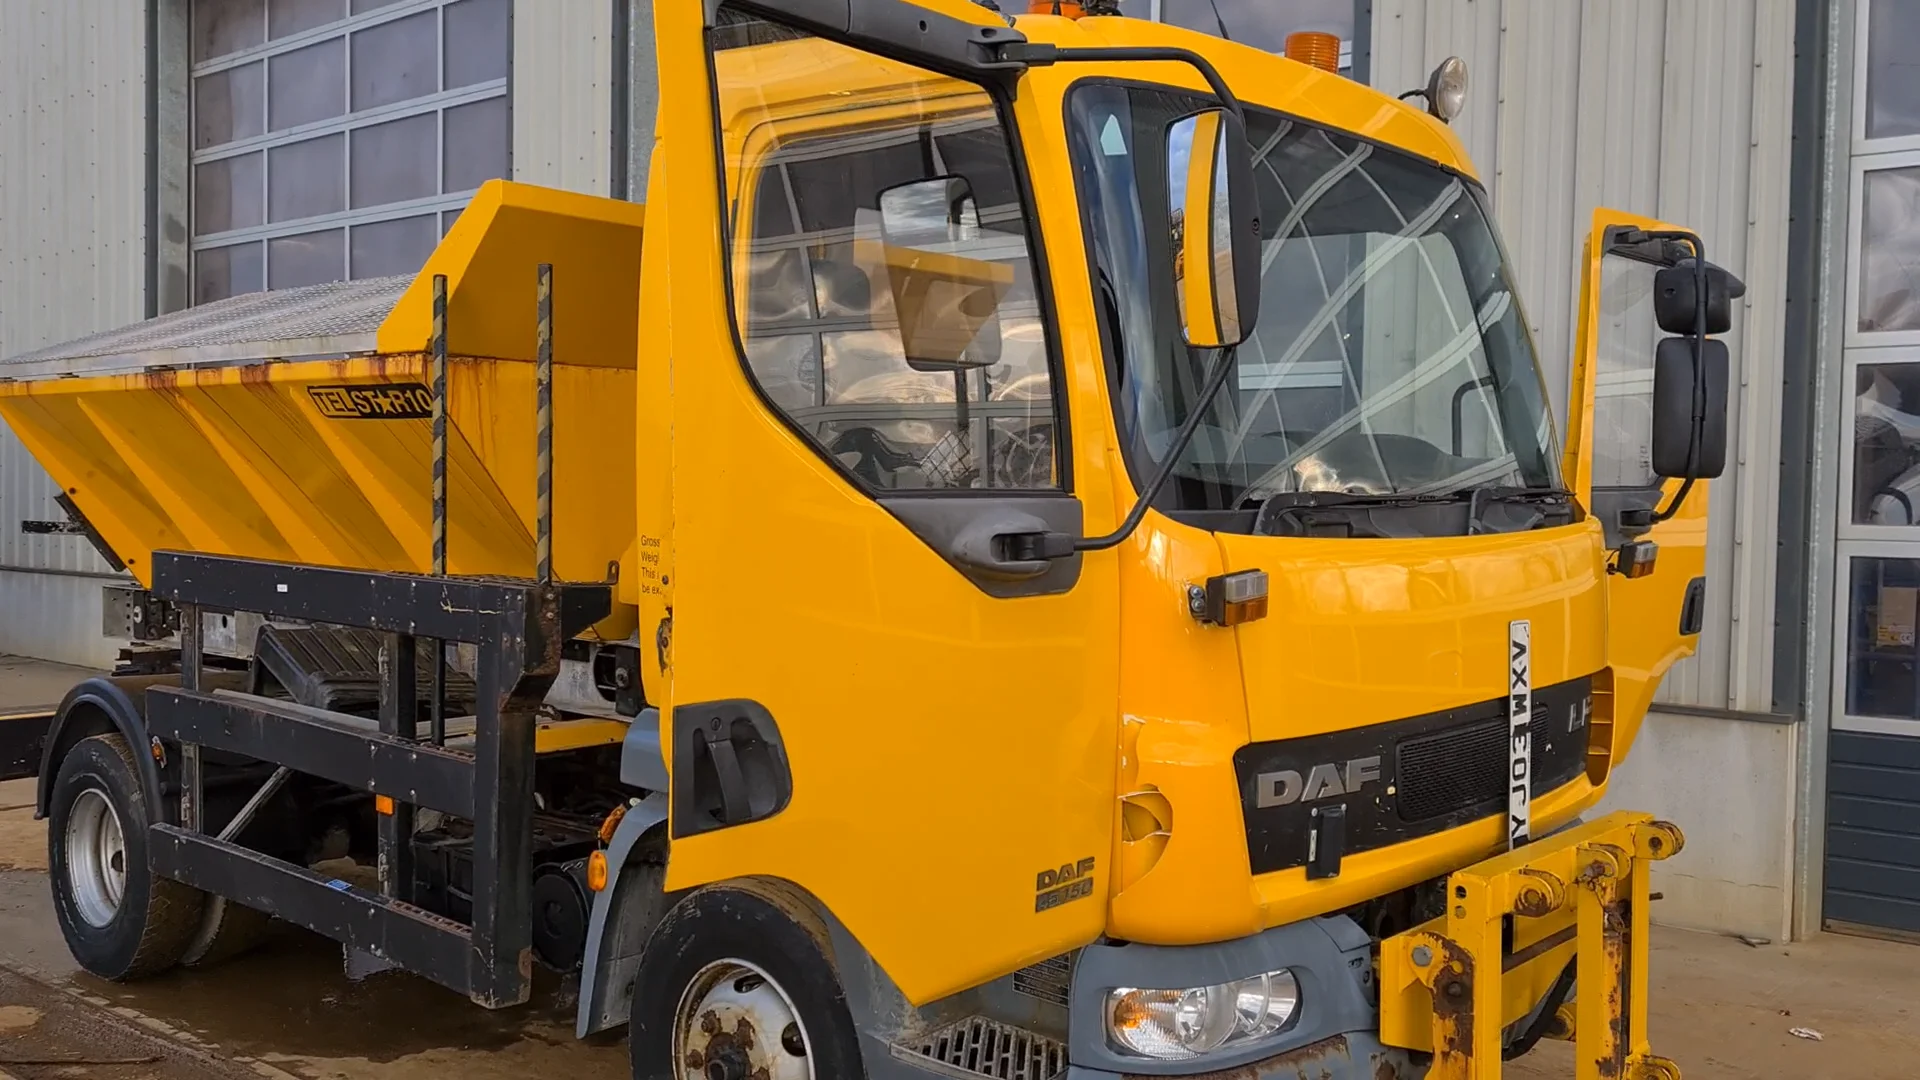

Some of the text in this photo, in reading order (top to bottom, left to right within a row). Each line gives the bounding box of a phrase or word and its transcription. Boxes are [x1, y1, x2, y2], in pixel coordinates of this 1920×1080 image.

[641, 535, 660, 547] Gross
[1257, 755, 1381, 808] DAF
[1037, 856, 1095, 892] DAF
